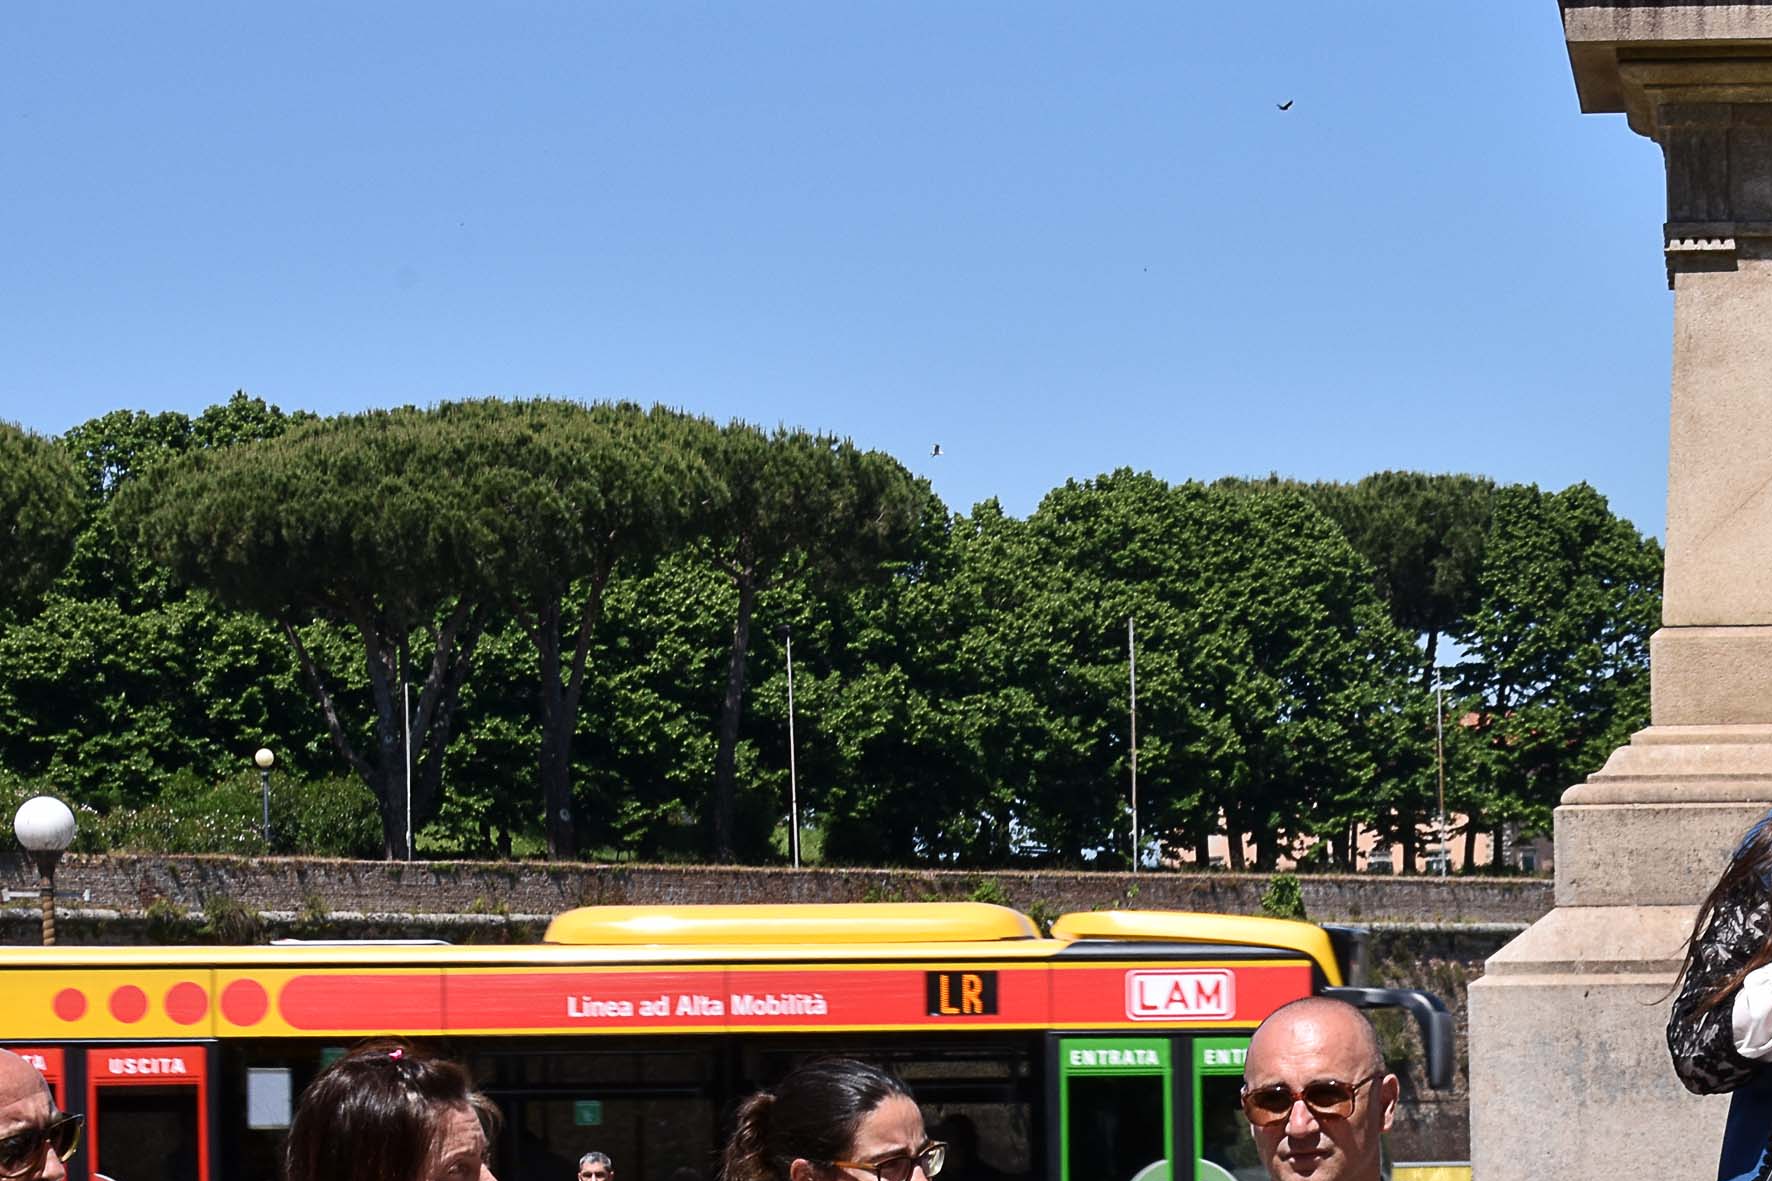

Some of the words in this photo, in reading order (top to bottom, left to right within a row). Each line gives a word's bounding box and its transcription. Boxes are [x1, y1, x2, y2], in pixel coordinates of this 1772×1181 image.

[567, 996, 634, 1017] Linea
[639, 995, 670, 1017] ad
[675, 995, 725, 1016] Alta
[730, 993, 828, 1015] Mobilità
[939, 974, 984, 1014] LR
[1139, 980, 1222, 1011] LAM
[108, 1058, 186, 1073] USCITA
[1069, 1049, 1160, 1066] ENTRATA
